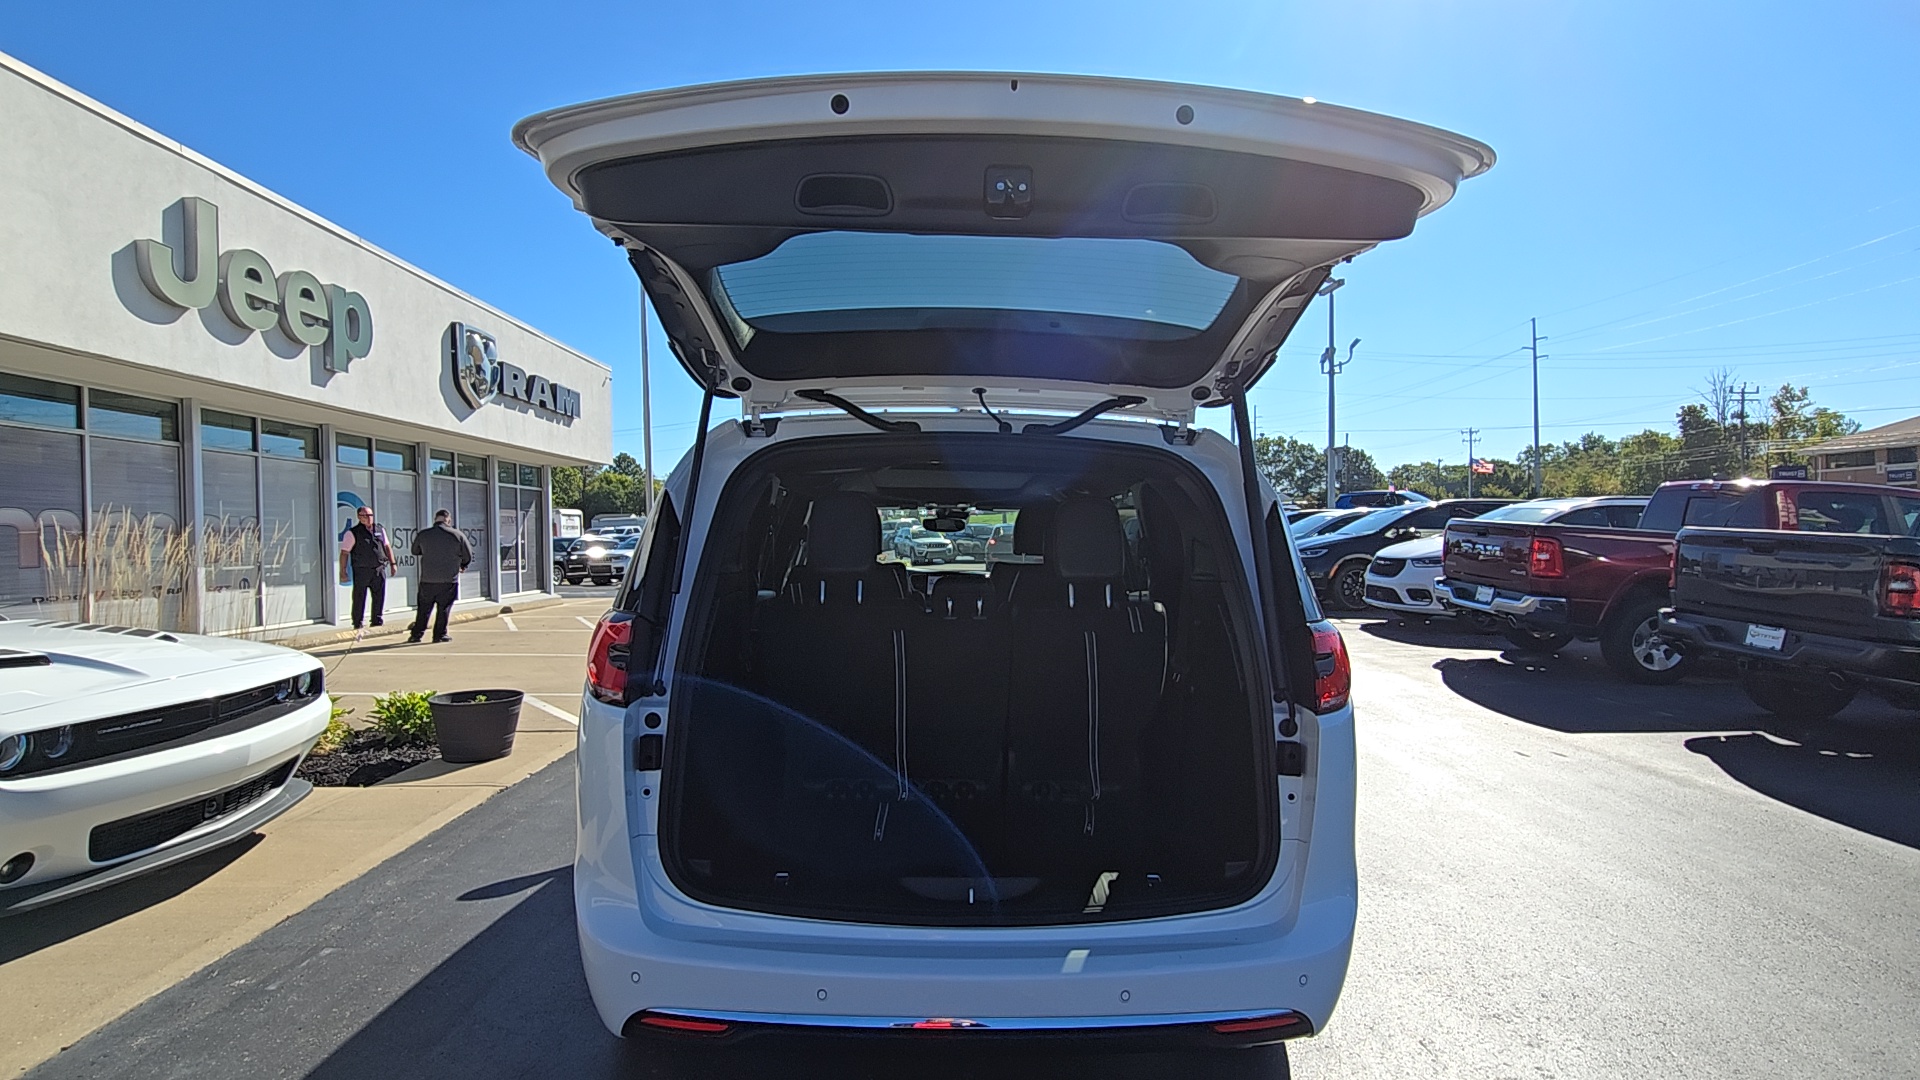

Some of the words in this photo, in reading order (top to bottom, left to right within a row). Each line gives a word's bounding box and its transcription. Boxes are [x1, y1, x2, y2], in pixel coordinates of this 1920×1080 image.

[137, 197, 374, 374] Jeep
[497, 361, 582, 419] RAM
[1778, 470, 1798, 478] TRUIST
